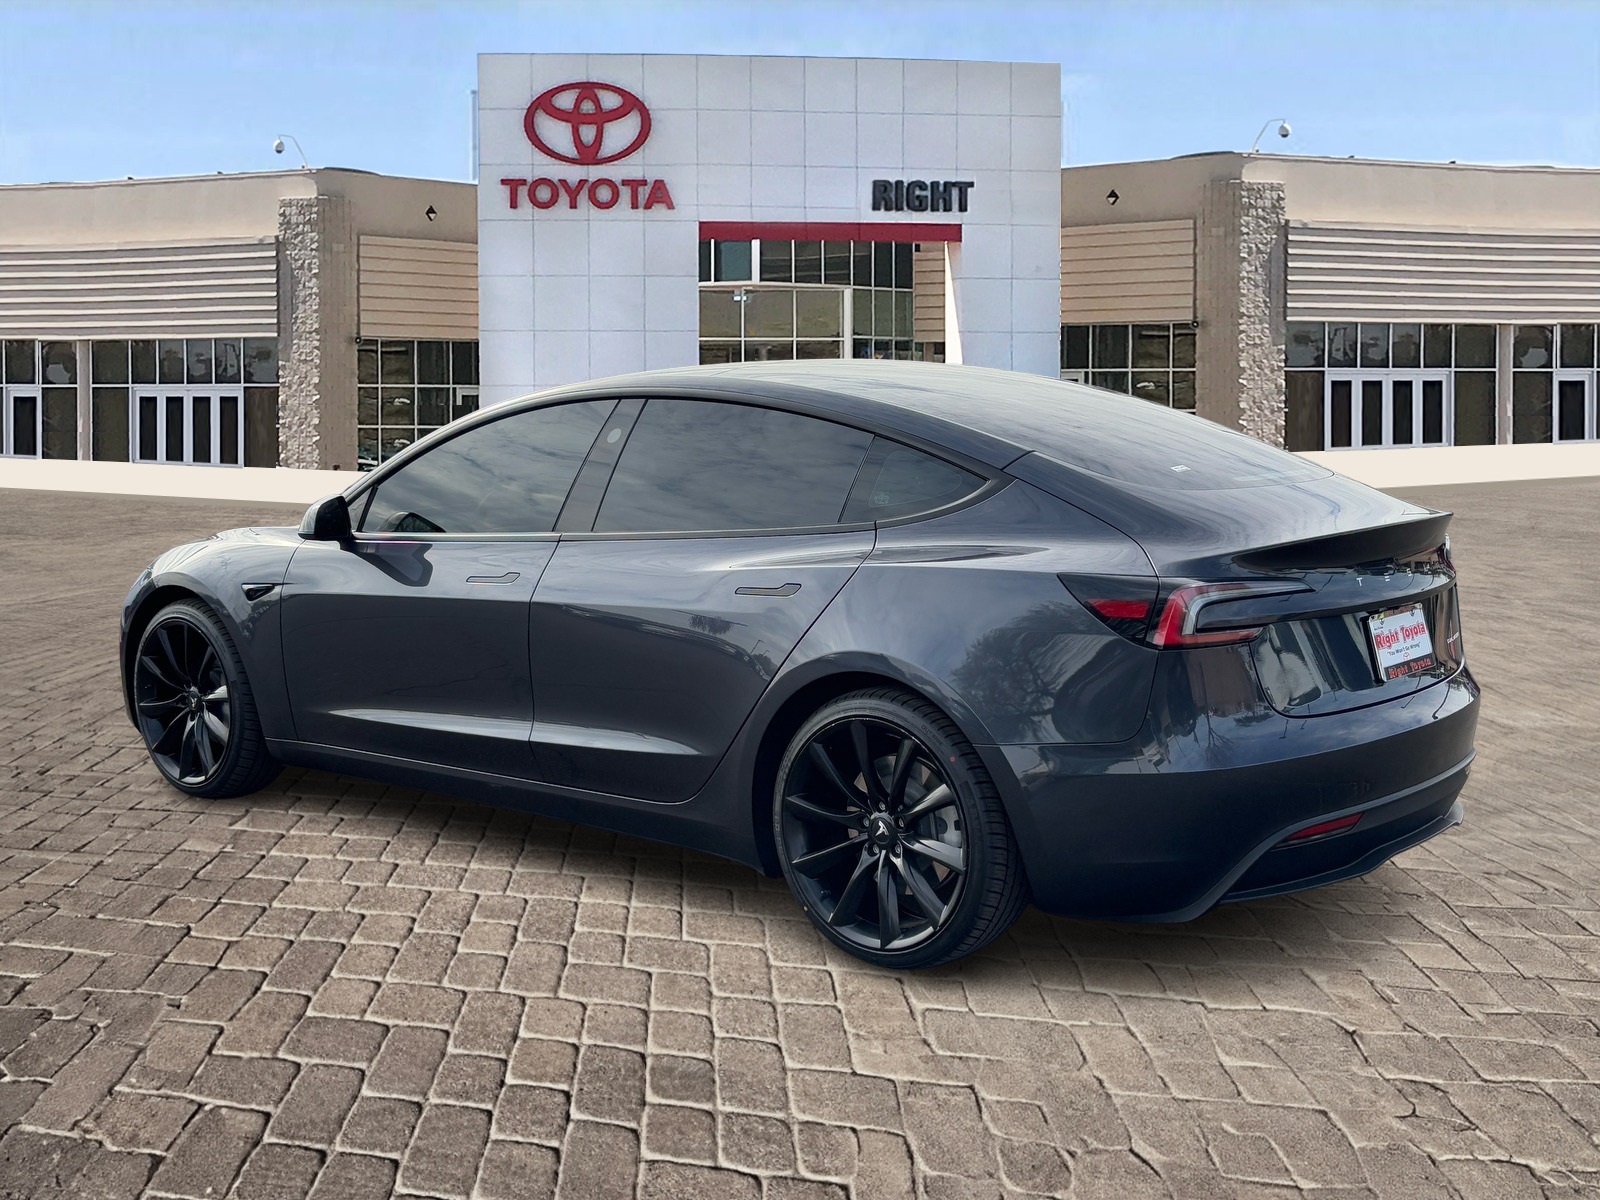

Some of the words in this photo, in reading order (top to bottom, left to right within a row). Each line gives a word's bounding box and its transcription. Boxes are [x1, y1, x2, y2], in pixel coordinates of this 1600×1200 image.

[500, 178, 675, 211] TOYOTA
[872, 179, 976, 212] RIGHT
[1356, 561, 1442, 587] TESL
[1375, 629, 1400, 650] Right
[1400, 621, 1427, 643] Toyota
[1388, 665, 1409, 679] Right
[1410, 658, 1432, 672] Toyota
